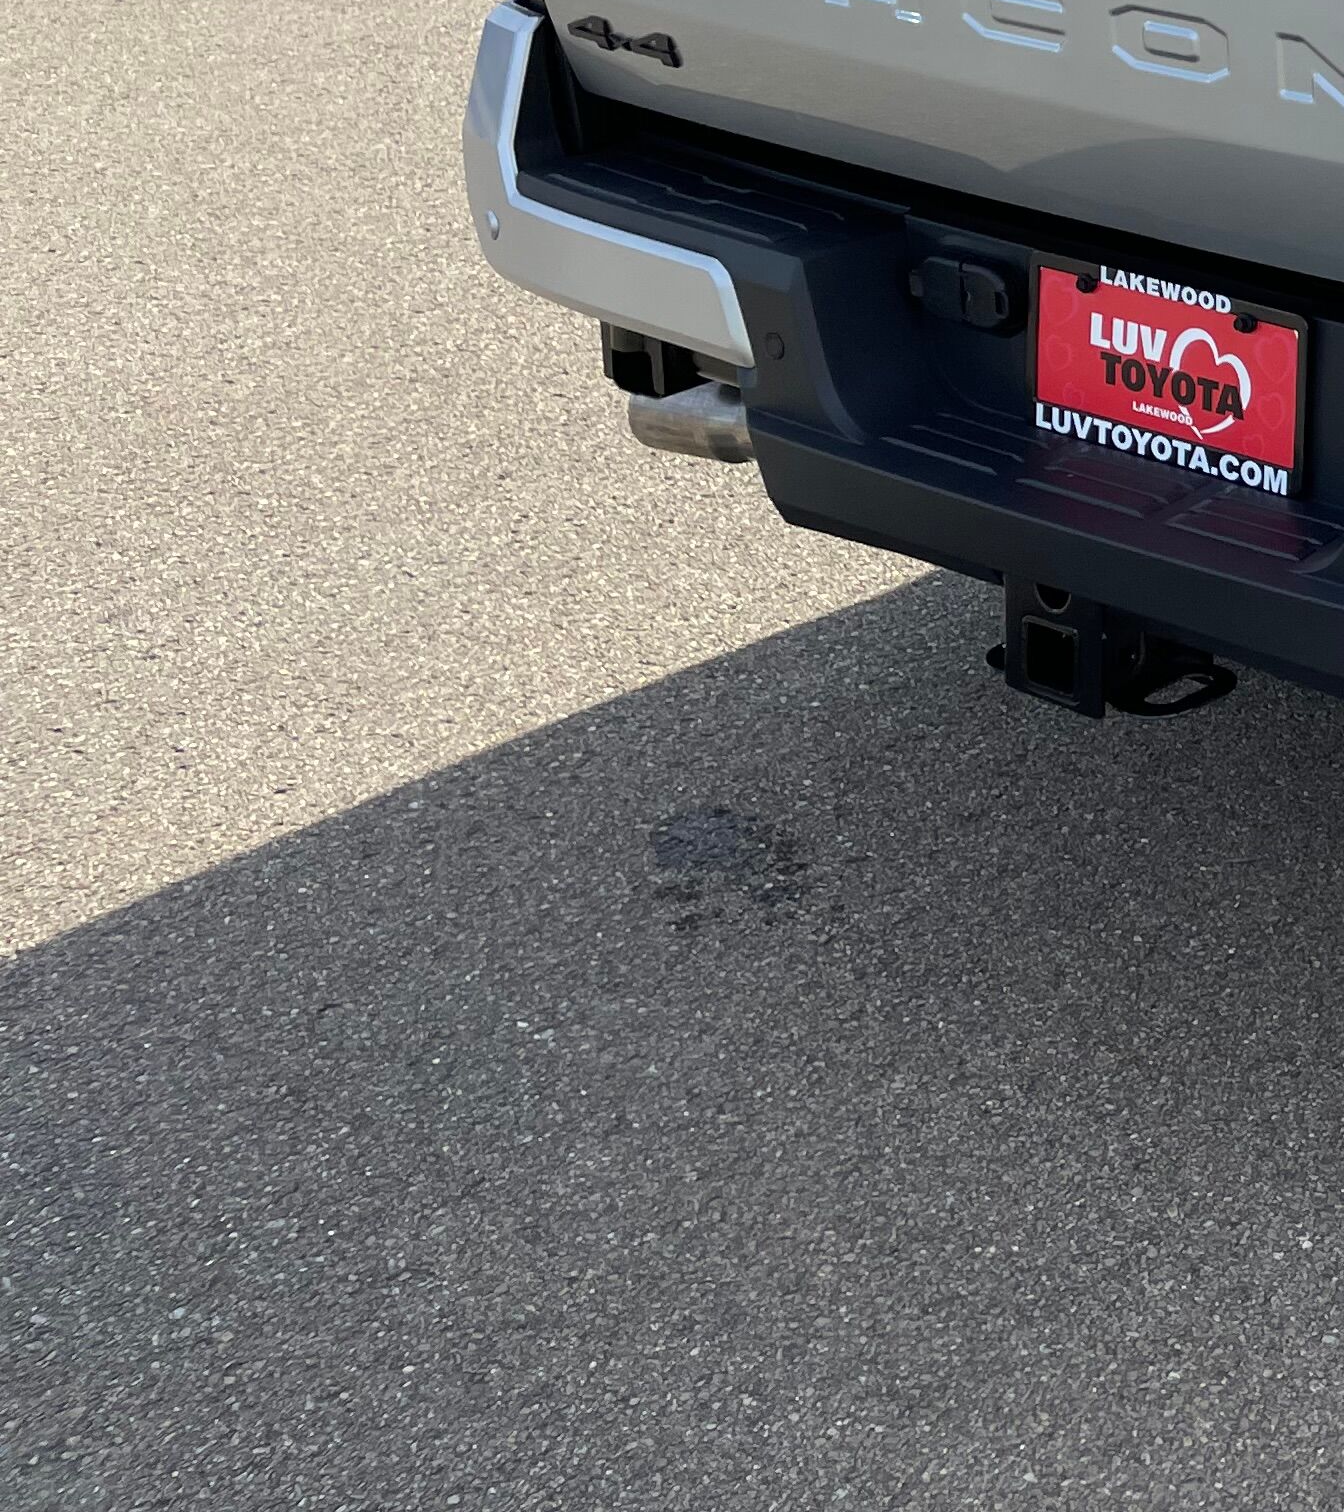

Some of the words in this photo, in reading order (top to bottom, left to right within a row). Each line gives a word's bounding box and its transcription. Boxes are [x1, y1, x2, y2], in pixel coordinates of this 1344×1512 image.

[1100, 265, 1232, 314] LAKEWOOD
[1090, 312, 1168, 362] LUV
[1100, 351, 1245, 420] TOYOTA
[1132, 401, 1194, 426] LAKEWOOD
[1035, 402, 1288, 496] LUVTOYOTA.COM
